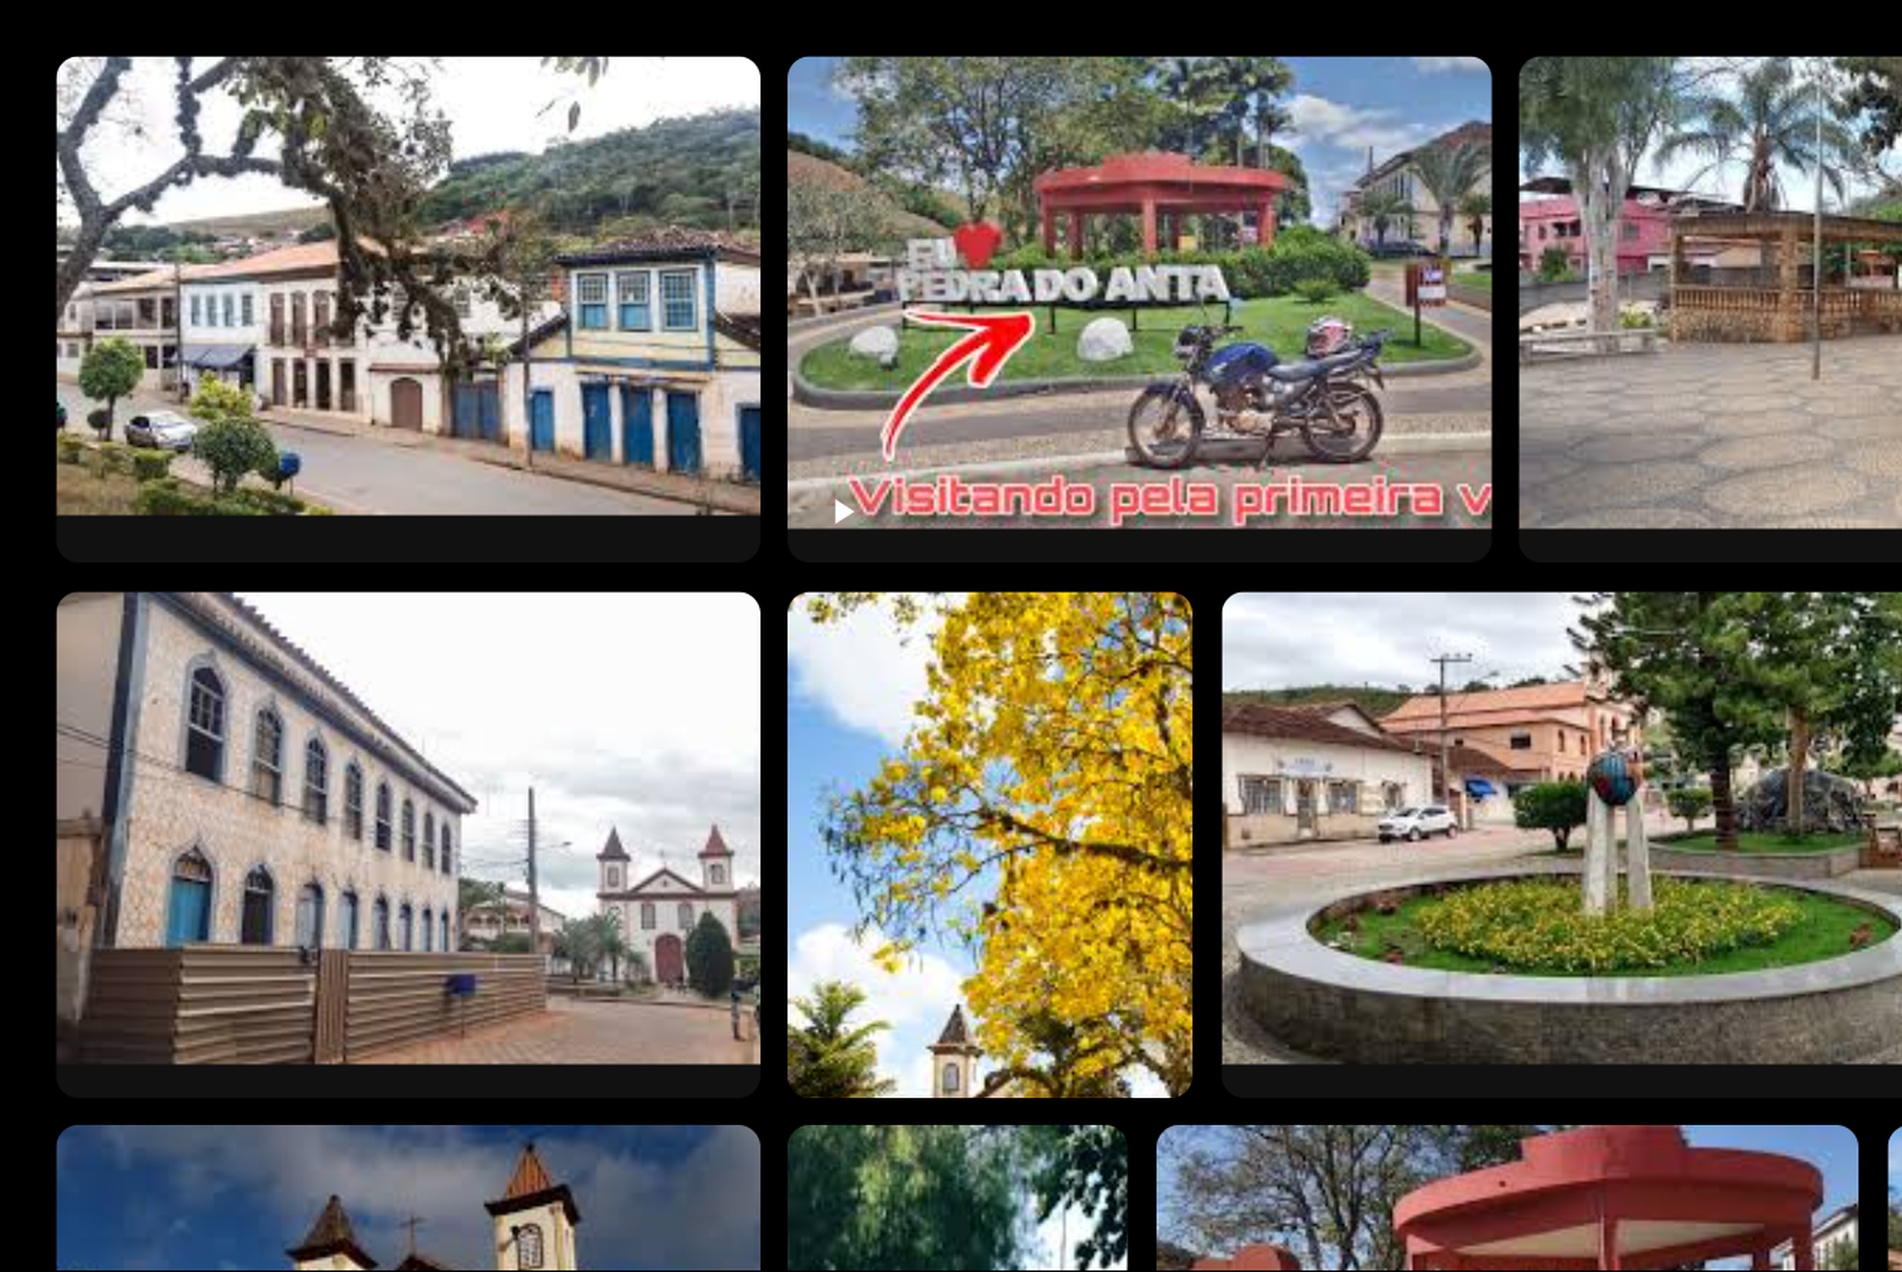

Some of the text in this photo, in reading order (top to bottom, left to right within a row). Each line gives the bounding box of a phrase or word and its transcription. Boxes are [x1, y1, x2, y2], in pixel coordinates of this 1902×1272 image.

[907, 238, 957, 269] EU
[898, 264, 1229, 301] PEDRA DO ANTA
